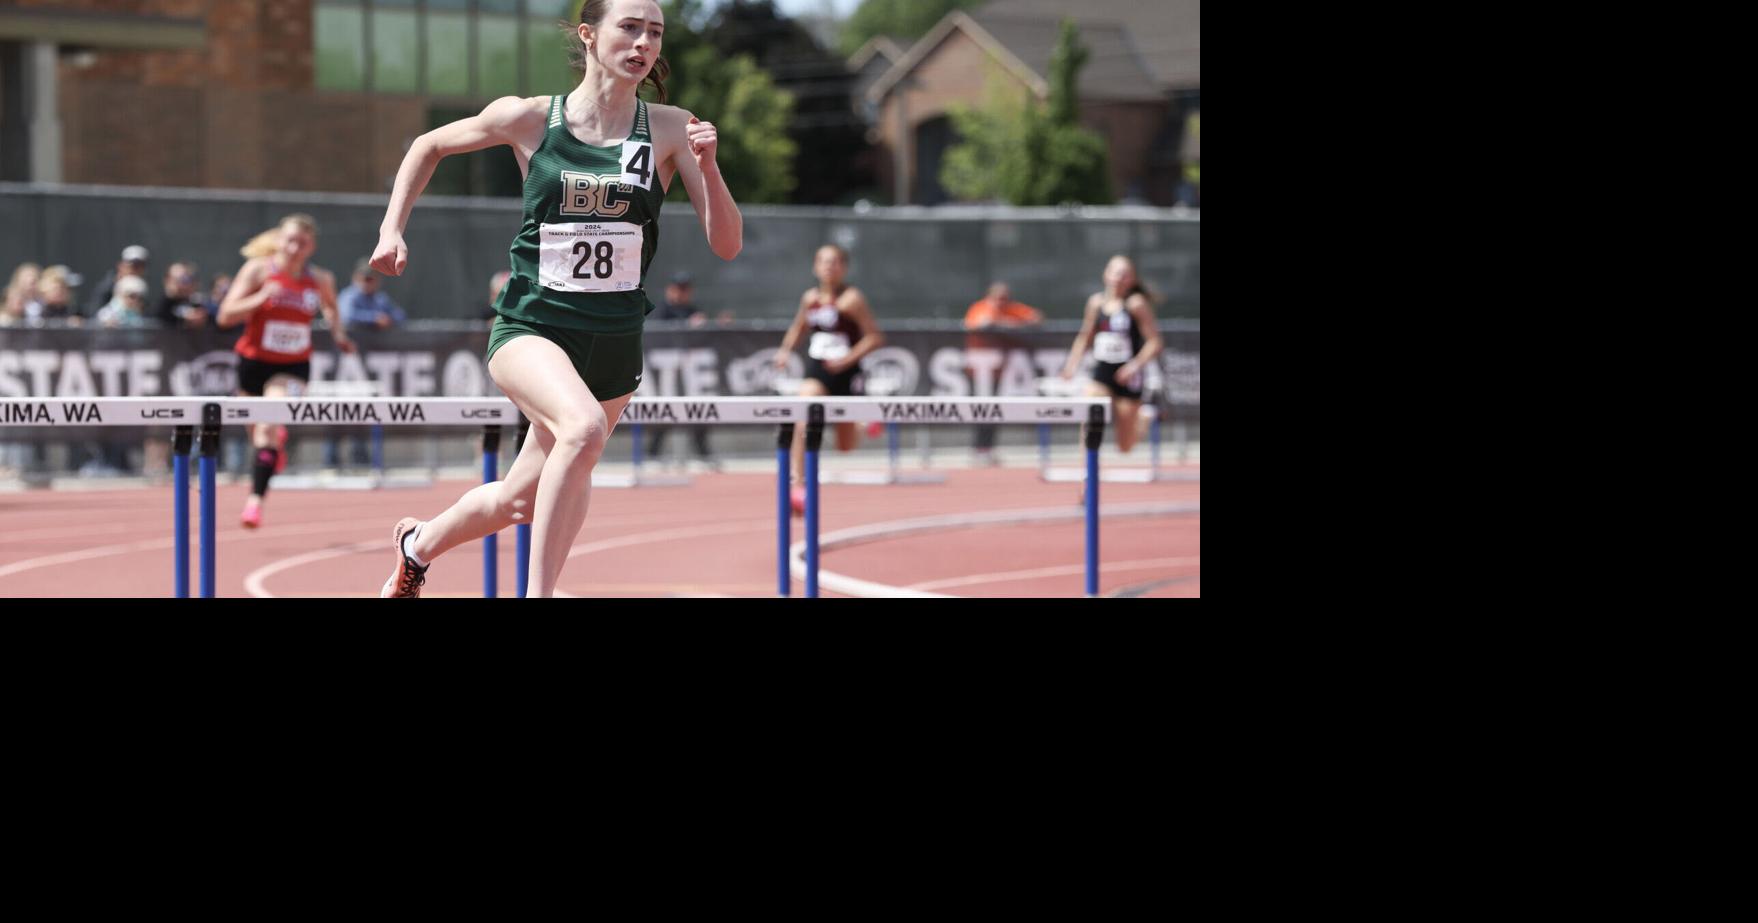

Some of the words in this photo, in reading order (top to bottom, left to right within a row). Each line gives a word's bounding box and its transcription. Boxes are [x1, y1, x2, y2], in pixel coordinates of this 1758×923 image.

[626, 145, 651, 185] 4
[560, 170, 632, 217] BC
[572, 241, 613, 279] 28
[63, 403, 102, 422] WA
[141, 408, 184, 418] UCS
[287, 403, 381, 423] YAKIMA,
[389, 403, 425, 422] WA
[461, 409, 502, 418] UCS
[684, 402, 719, 419] WA
[753, 408, 792, 417] UCS
[879, 403, 963, 421] YAKIMA,
[970, 402, 1003, 419] WA
